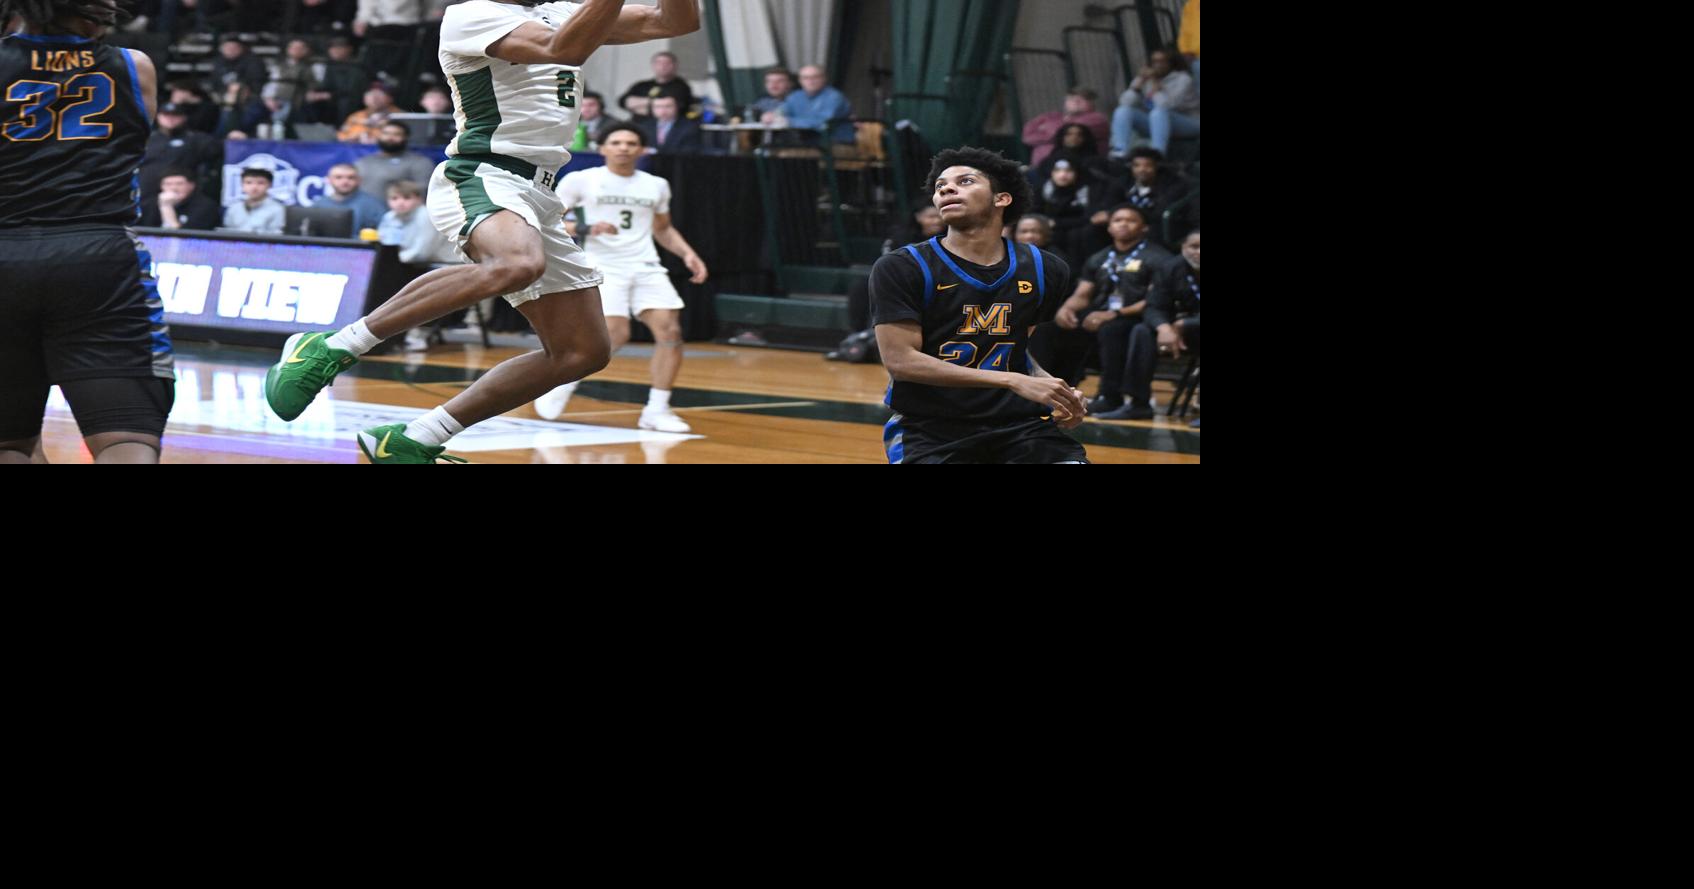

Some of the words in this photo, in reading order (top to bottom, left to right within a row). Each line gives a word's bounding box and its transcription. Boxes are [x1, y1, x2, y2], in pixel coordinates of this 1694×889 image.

[31, 50, 96, 72] LIONS
[556, 71, 575, 107] 2
[1, 72, 116, 142] 32
[541, 171, 553, 187] H
[619, 210, 633, 230] 3
[217, 267, 349, 325] VIEW
[956, 303, 1012, 335] M
[939, 341, 1016, 372] 24
